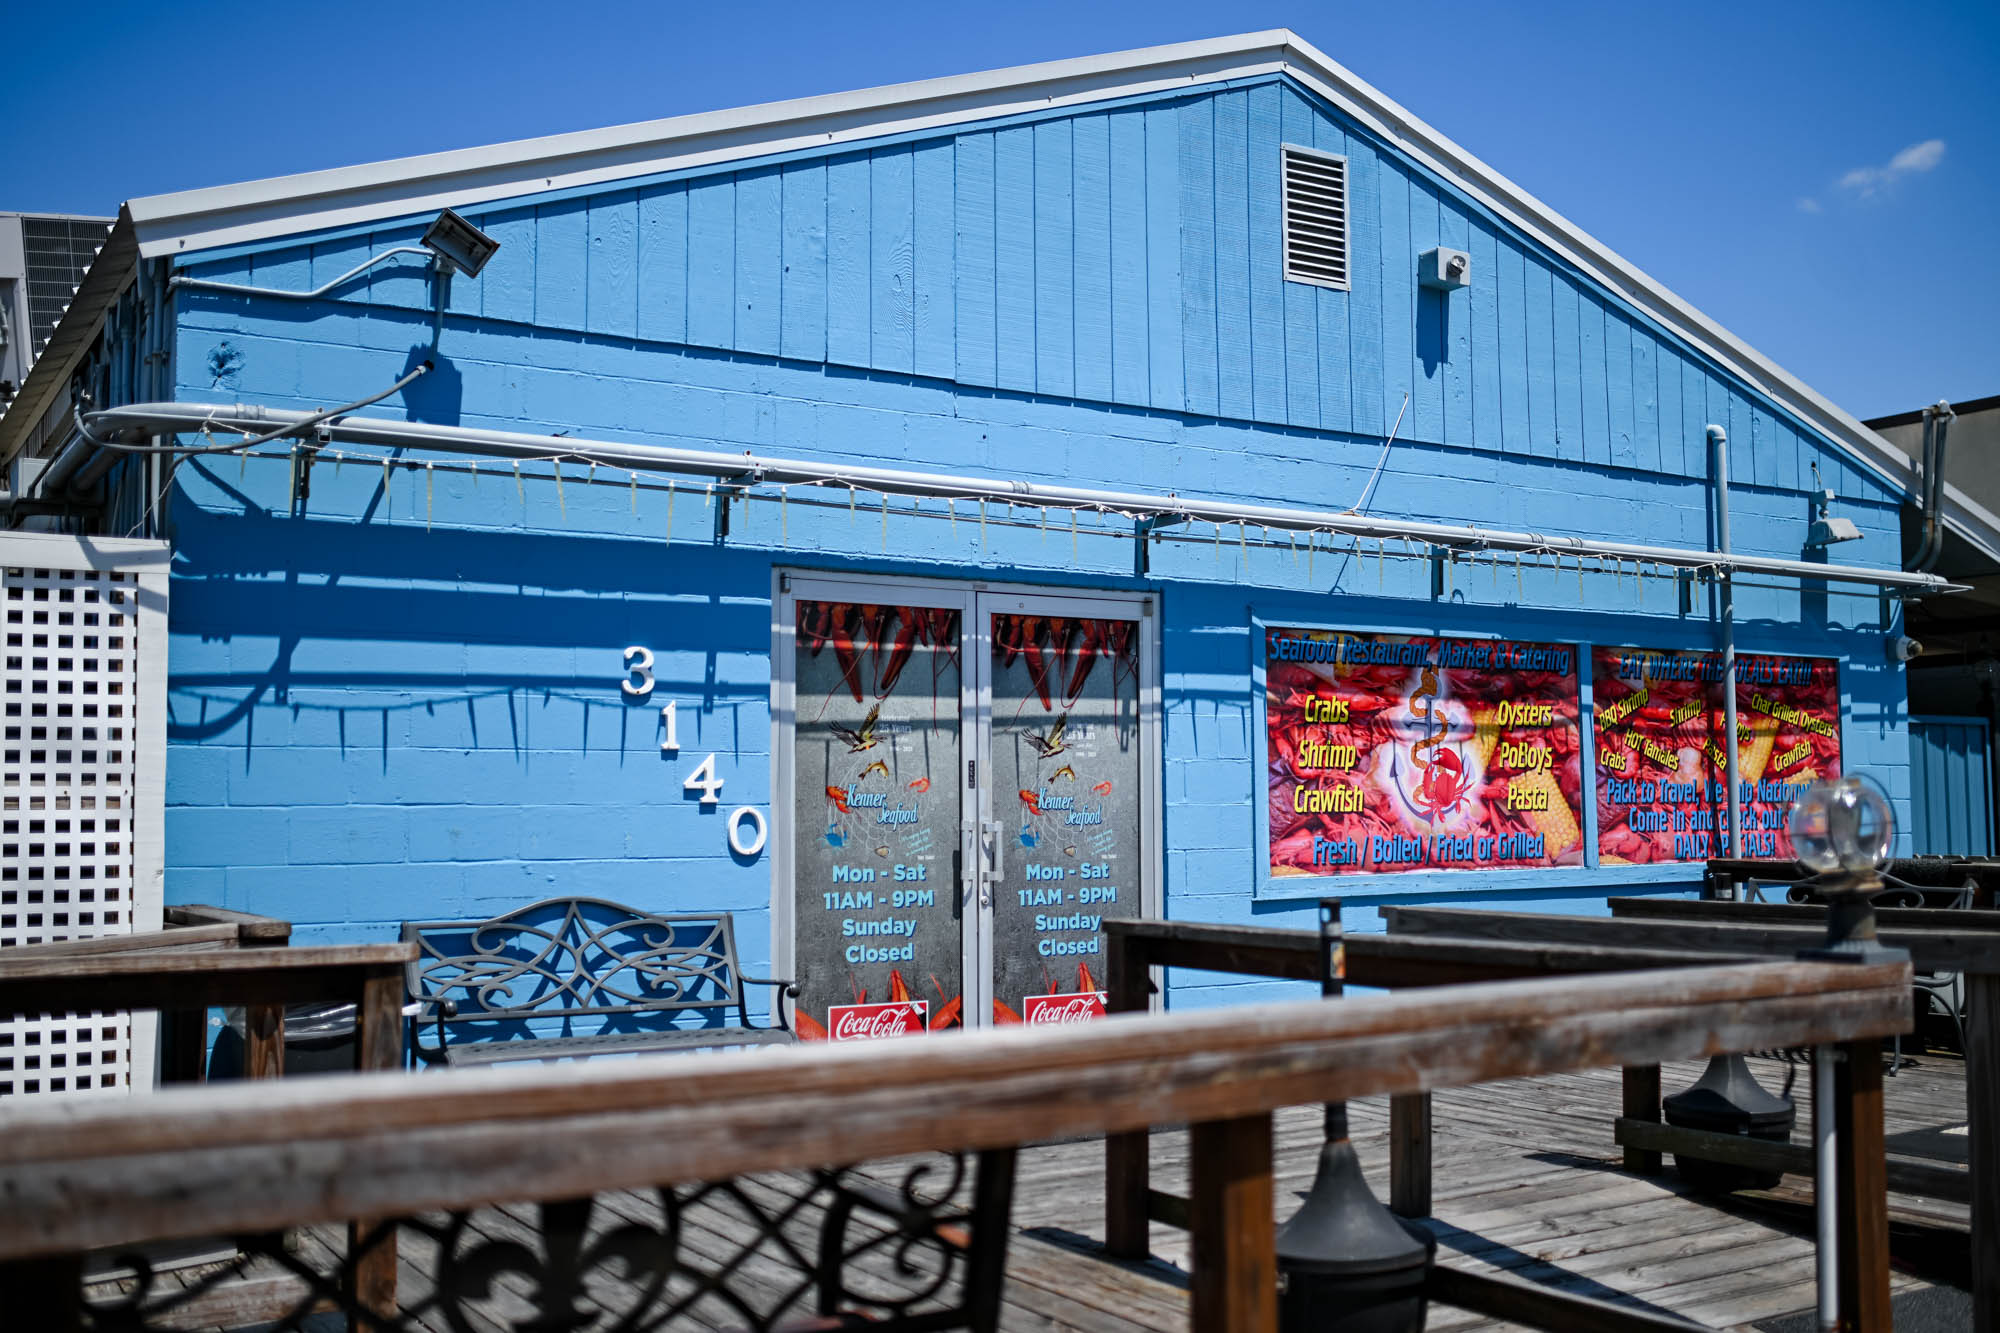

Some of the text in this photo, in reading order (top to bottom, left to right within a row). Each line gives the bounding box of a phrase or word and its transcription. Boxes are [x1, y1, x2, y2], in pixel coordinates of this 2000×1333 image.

[1269, 631, 1570, 677] Seafood Restaurant, Market & Catering
[1619, 653, 1812, 686] EAT WHERE THE OCALS EAT!!!
[1304, 694, 1349, 723] Crabs
[1498, 700, 1552, 731] Oysters
[1599, 688, 1649, 733] BBQ Shrimp
[1669, 699, 1702, 728] Shrimp
[1751, 693, 1834, 738] Char Grilled Oysters
[1298, 740, 1356, 772] Shrimp
[1499, 742, 1553, 772] PoBoys
[1600, 747, 1627, 772] Crabs
[1624, 728, 1680, 772] HOT Tamales
[1703, 736, 1728, 771] Pasta
[1774, 739, 1813, 773] Crawfish
[846, 783, 887, 808] Kenner
[1038, 787, 1074, 811] Kenner
[1294, 785, 1364, 813] Crawfish
[1507, 784, 1548, 811] Pasta
[1607, 778, 1637, 804] Pack
[1641, 780, 1656, 804] to
[1660, 778, 1700, 806] Travel,
[1703, 779, 1723, 804] We
[877, 802, 918, 832] Seafood
[1064, 803, 1102, 832] Seafood
[1629, 807, 1668, 832] Come
[1672, 806, 1687, 832] in
[1690, 807, 1715, 832] and
[1720, 806, 1758, 831] cck
[1762, 807, 1785, 831] out
[1312, 836, 1357, 866] Fresh
[1373, 834, 1423, 864] Boiled
[1437, 833, 1474, 861] Fried
[1479, 836, 1493, 860] or
[1499, 832, 1544, 860] Grilled
[1674, 832, 1776, 858] DAILY SPIALS!
[832, 864, 876, 883] Mon
[893, 863, 926, 882] Sat
[1025, 863, 1064, 881] Mon
[1080, 862, 1110, 880] Sat
[823, 890, 874, 910] 11AM
[892, 889, 935, 908] 9PM
[1017, 887, 1063, 907] 11AM
[1079, 886, 1118, 905] 9PM
[842, 916, 917, 938] Sunday
[1035, 912, 1102, 933] Sunday
[845, 942, 914, 964] Closed
[1038, 935, 1100, 957] Closed
